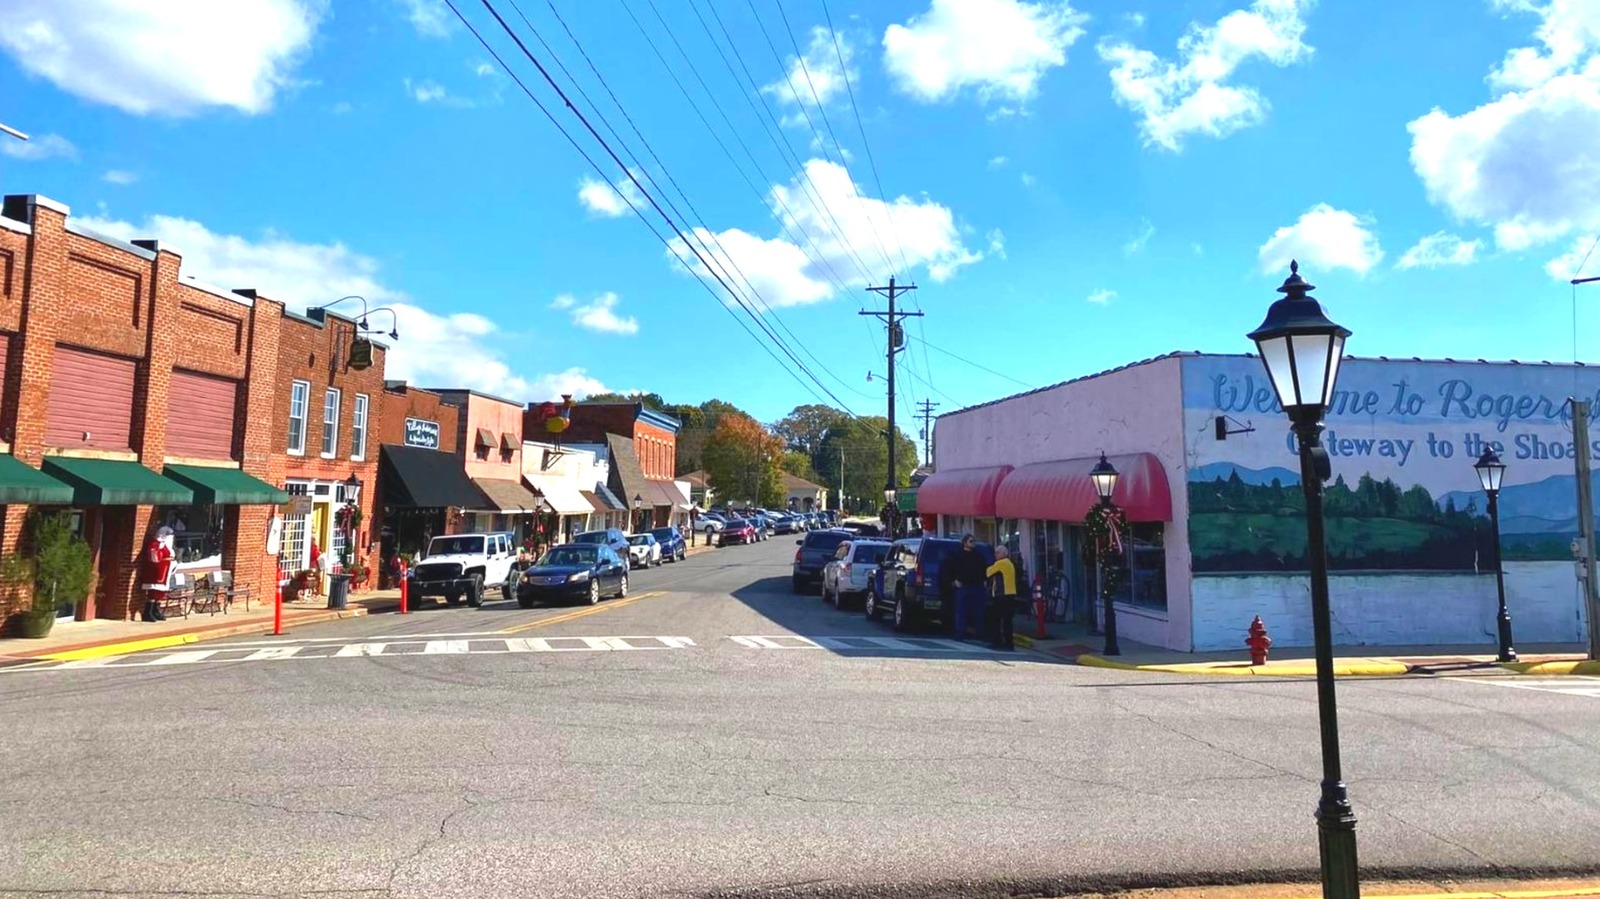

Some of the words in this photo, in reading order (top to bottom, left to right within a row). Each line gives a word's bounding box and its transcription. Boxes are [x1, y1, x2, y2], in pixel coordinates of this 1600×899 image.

[1387, 379, 1425, 416] to
[1427, 432, 1454, 458] to
[1464, 432, 1504, 458] the
[1514, 434, 1600, 460] Shoas
